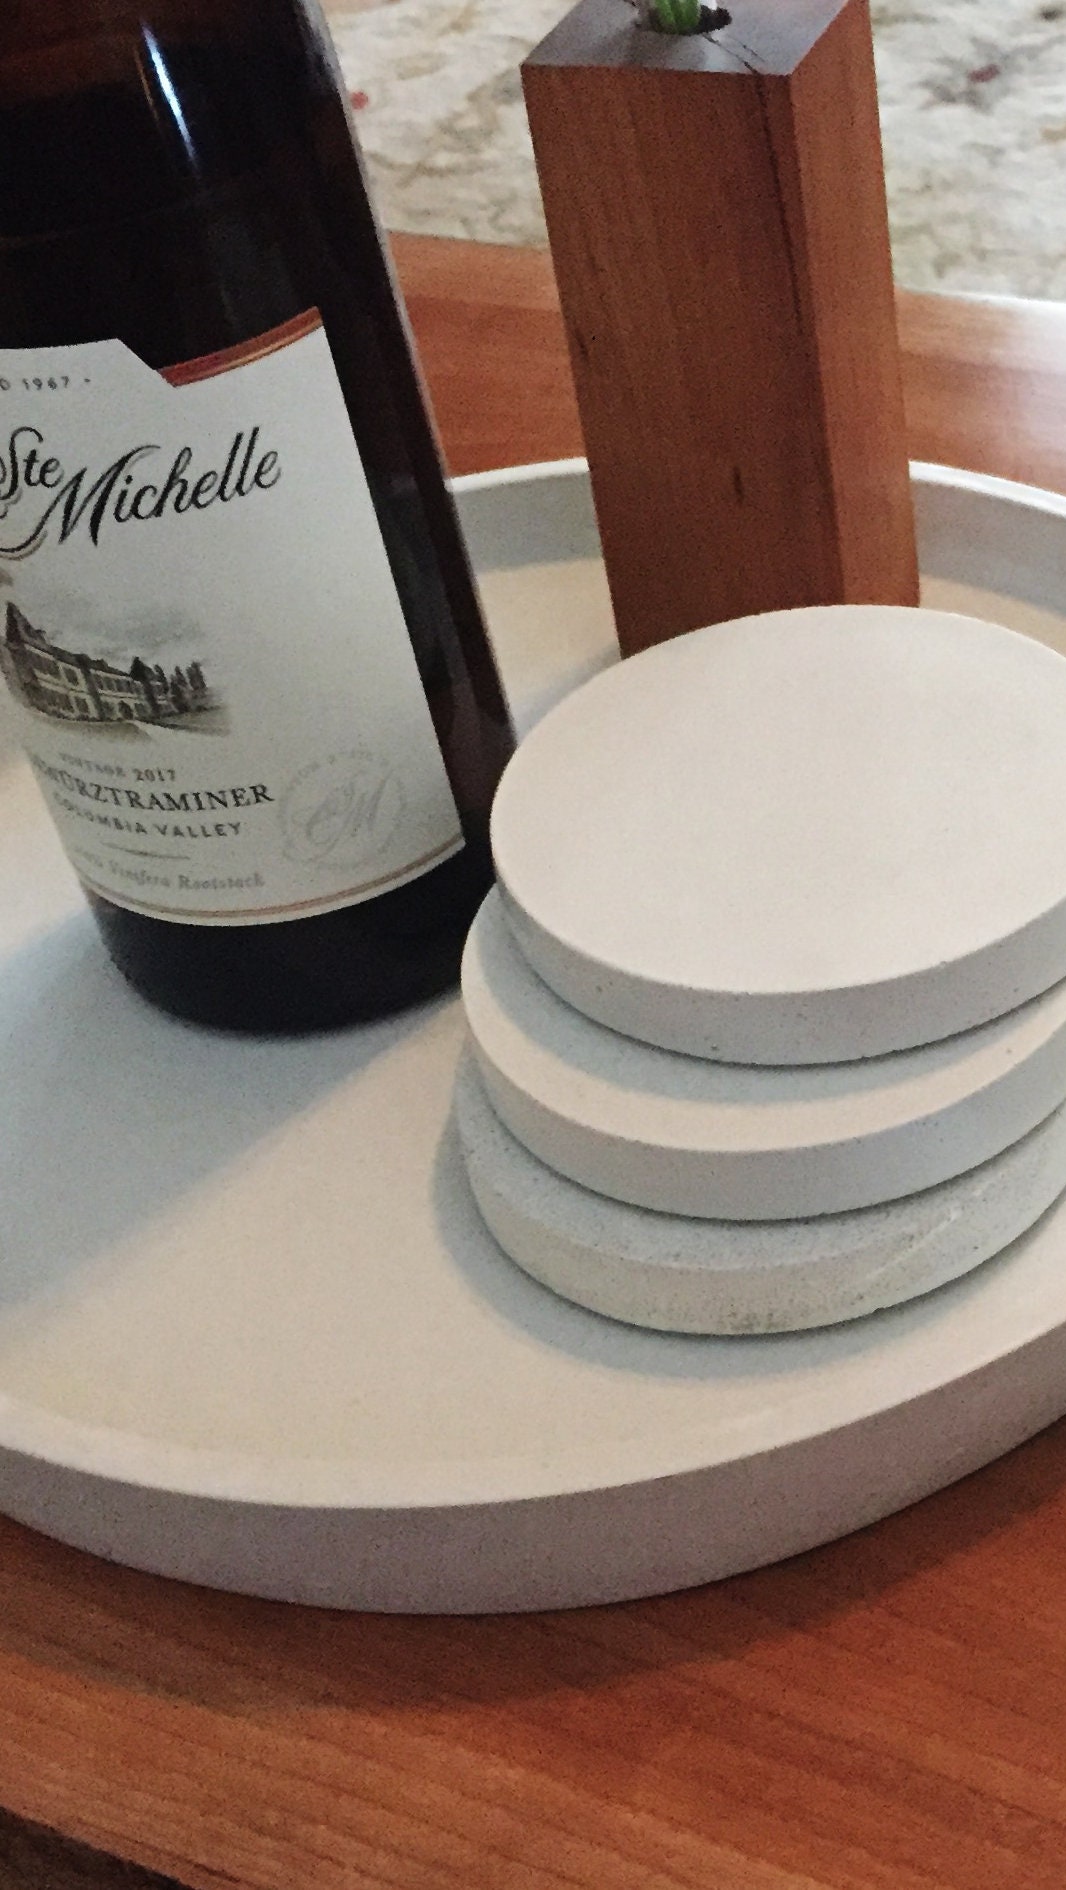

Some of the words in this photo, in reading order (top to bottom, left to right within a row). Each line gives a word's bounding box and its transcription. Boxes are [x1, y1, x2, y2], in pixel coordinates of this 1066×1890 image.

[22, 375, 69, 391] 1967
[0, 426, 64, 502] Ste
[24, 426, 281, 549] Michelle
[131, 767, 177, 782] 2017
[153, 820, 241, 838] VALLEY
